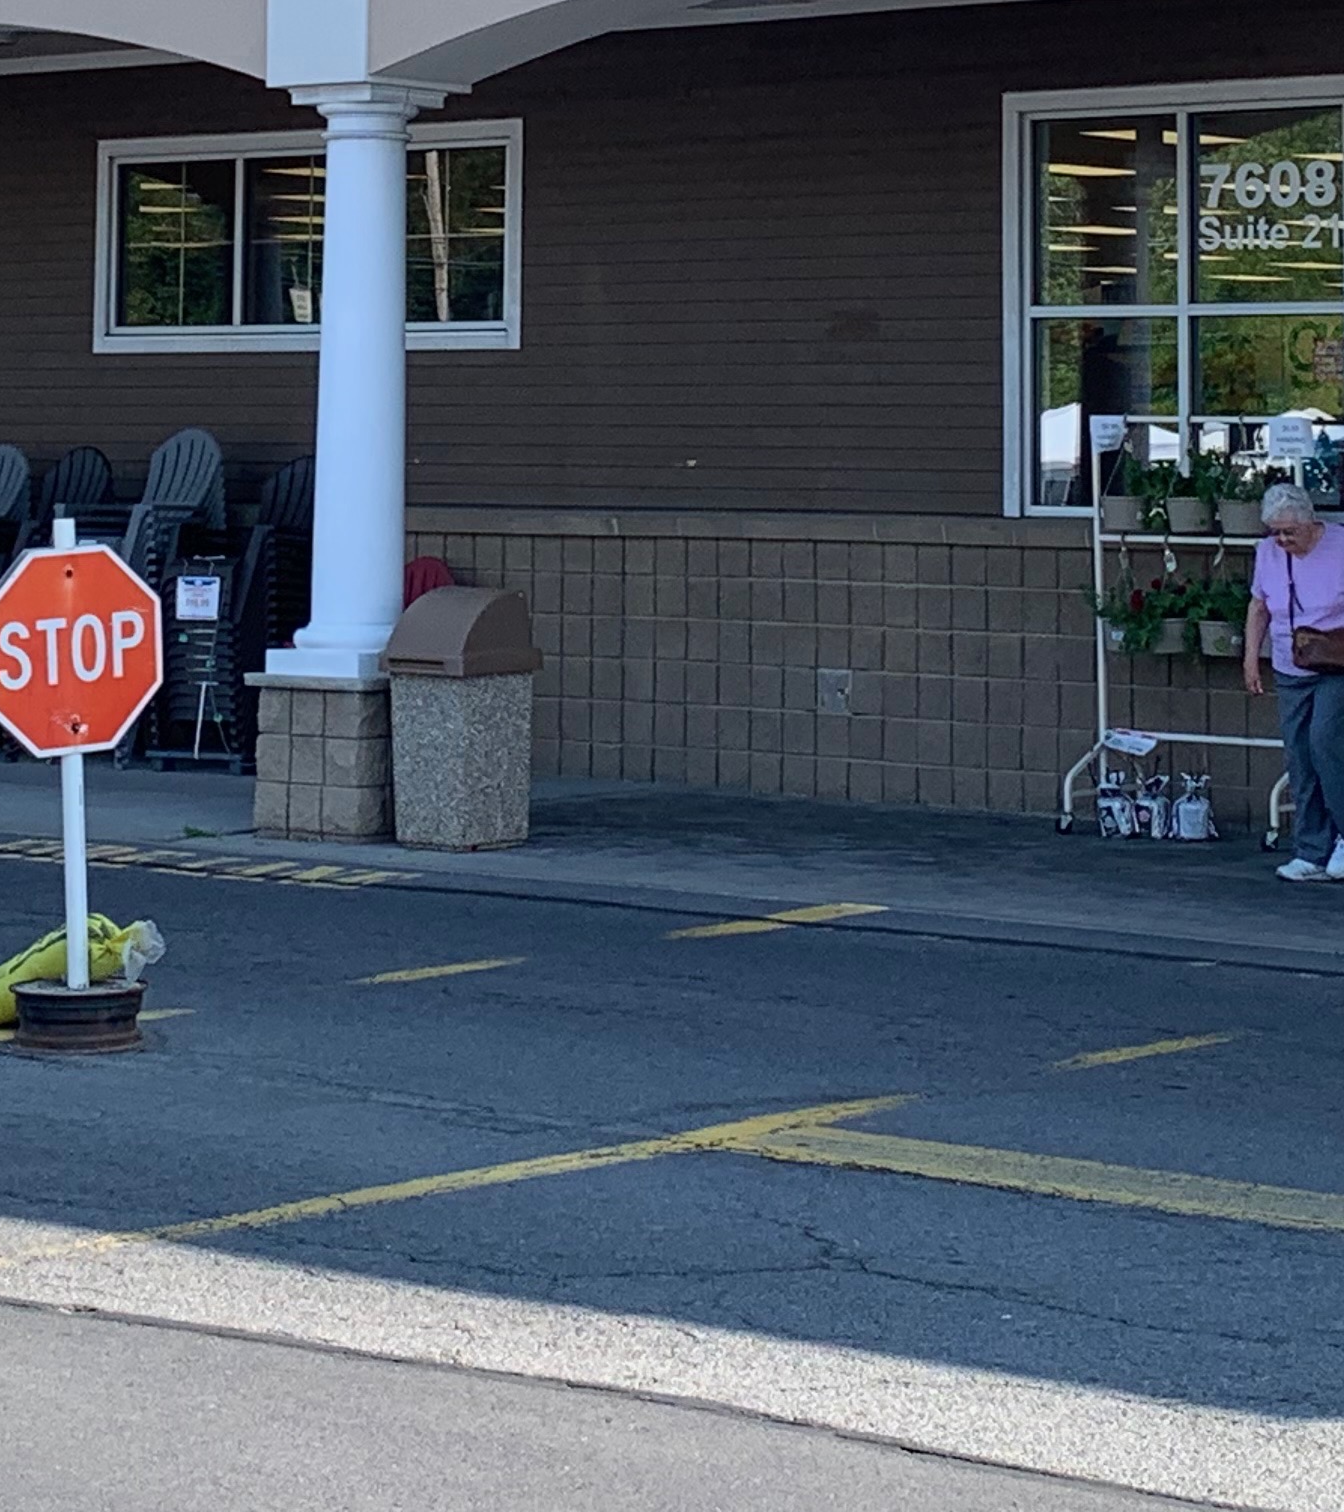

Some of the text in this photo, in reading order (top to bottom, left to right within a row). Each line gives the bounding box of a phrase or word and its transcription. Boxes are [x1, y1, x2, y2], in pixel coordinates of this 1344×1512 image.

[1199, 160, 1337, 208] 7608
[1198, 213, 1340, 251] Suite 21
